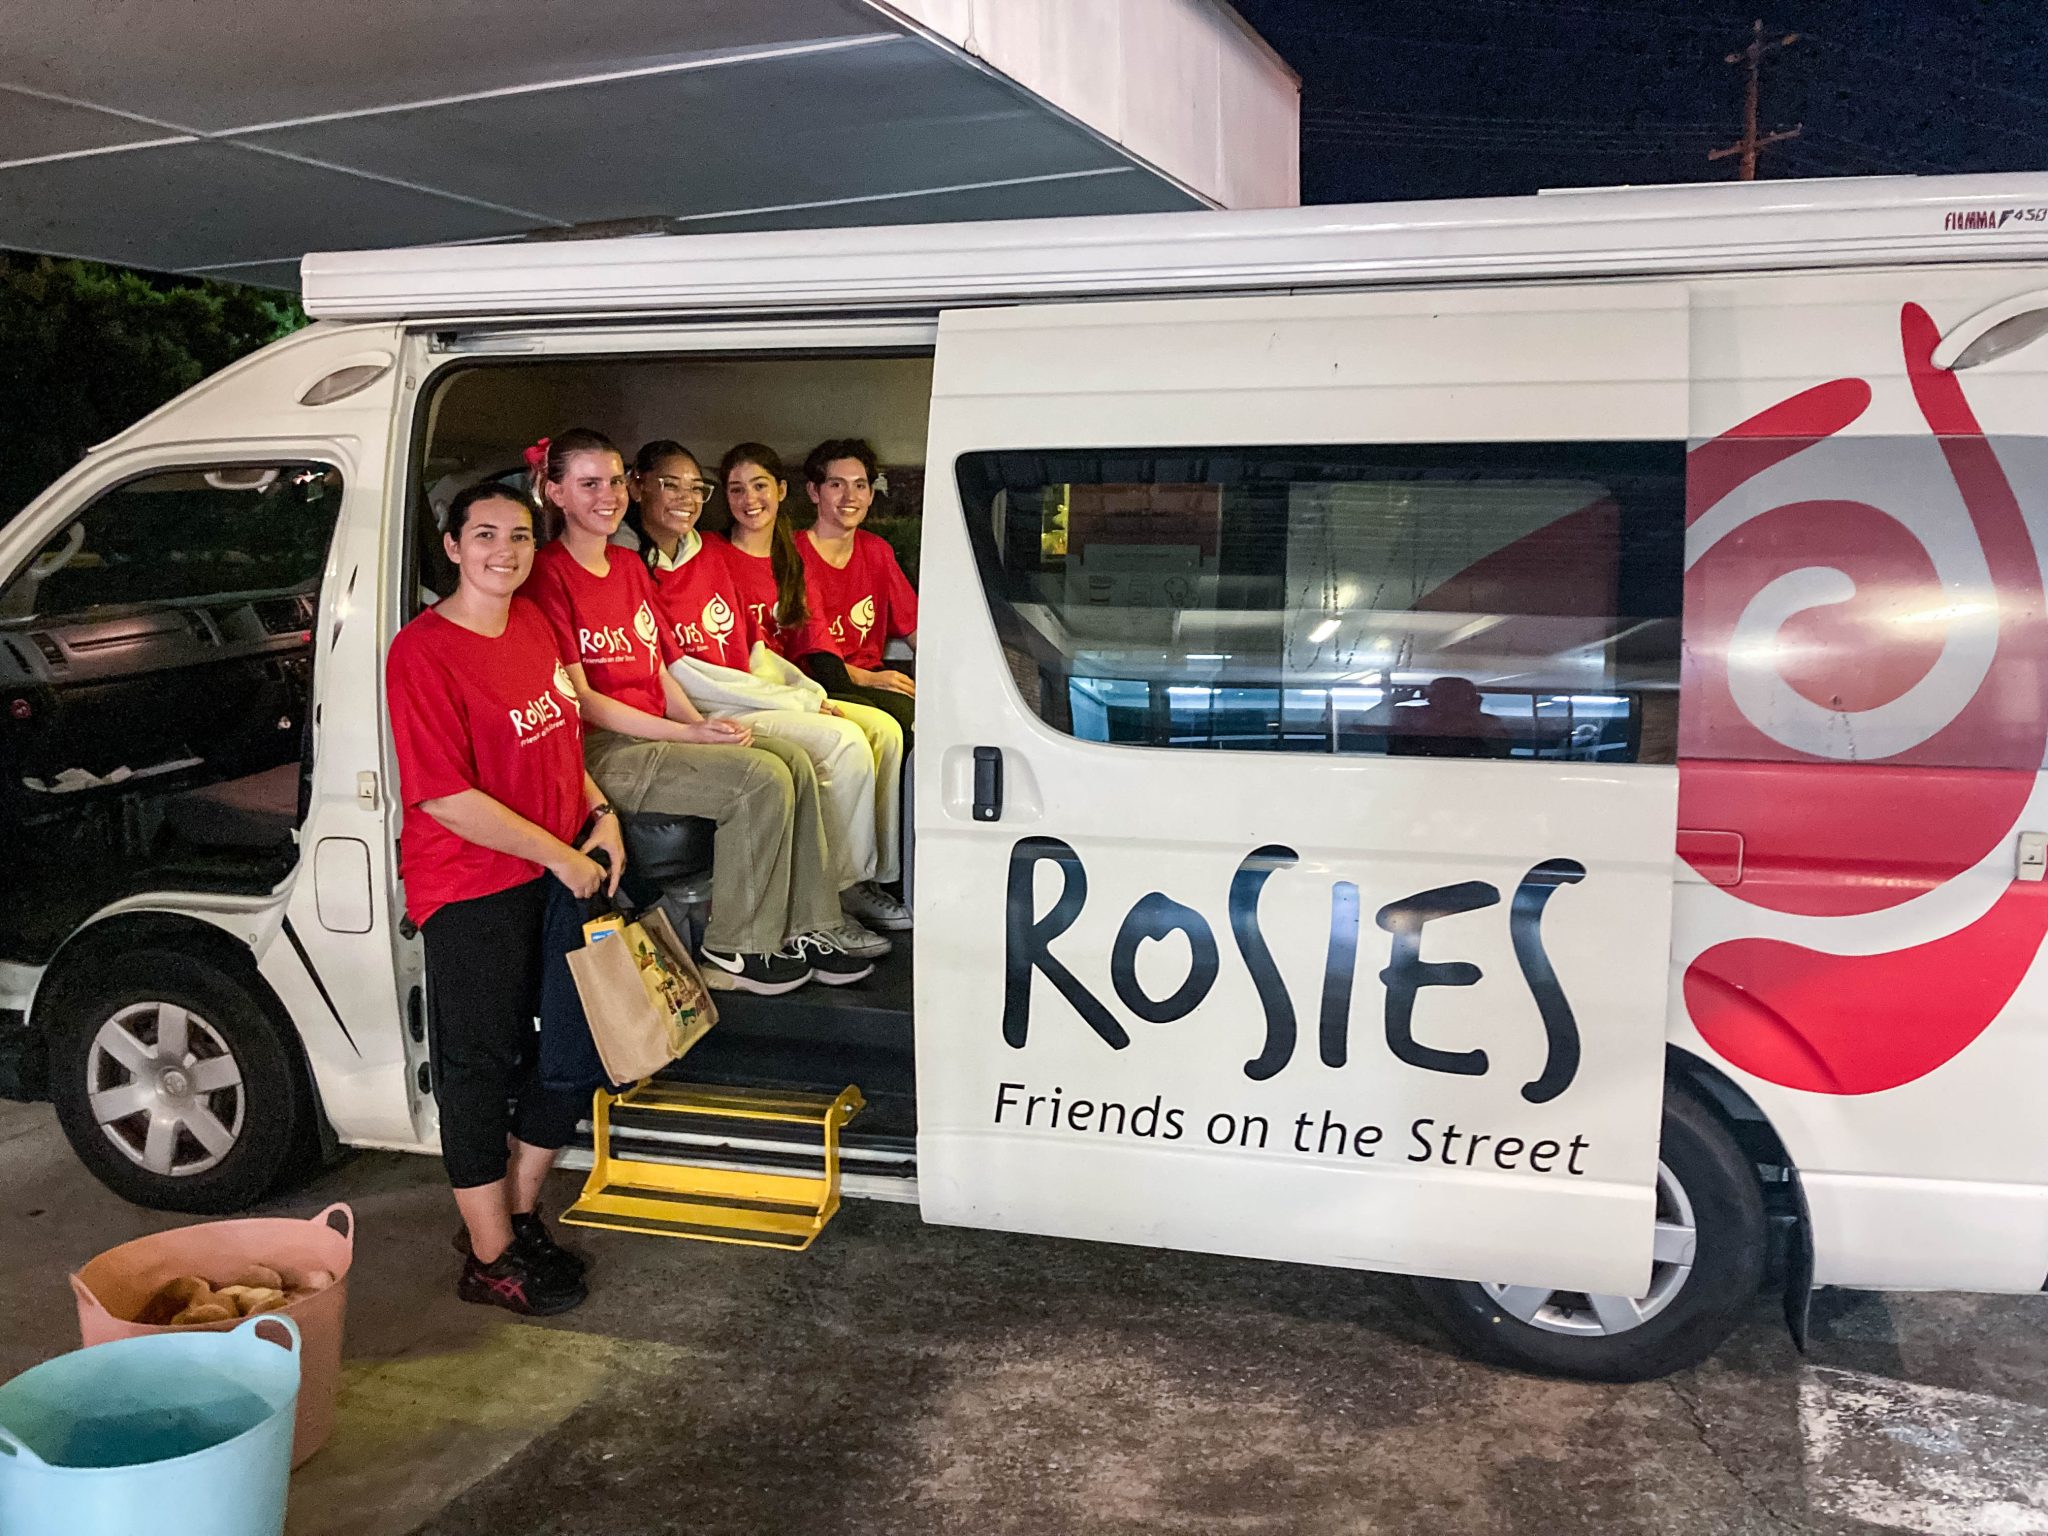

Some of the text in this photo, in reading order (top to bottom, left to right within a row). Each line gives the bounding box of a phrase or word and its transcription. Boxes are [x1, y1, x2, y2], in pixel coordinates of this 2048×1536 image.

[1944, 210, 1996, 231] FIAMMA
[1002, 836, 1587, 1104] ROSIES
[994, 1082, 1590, 1176] Friends on the Street
